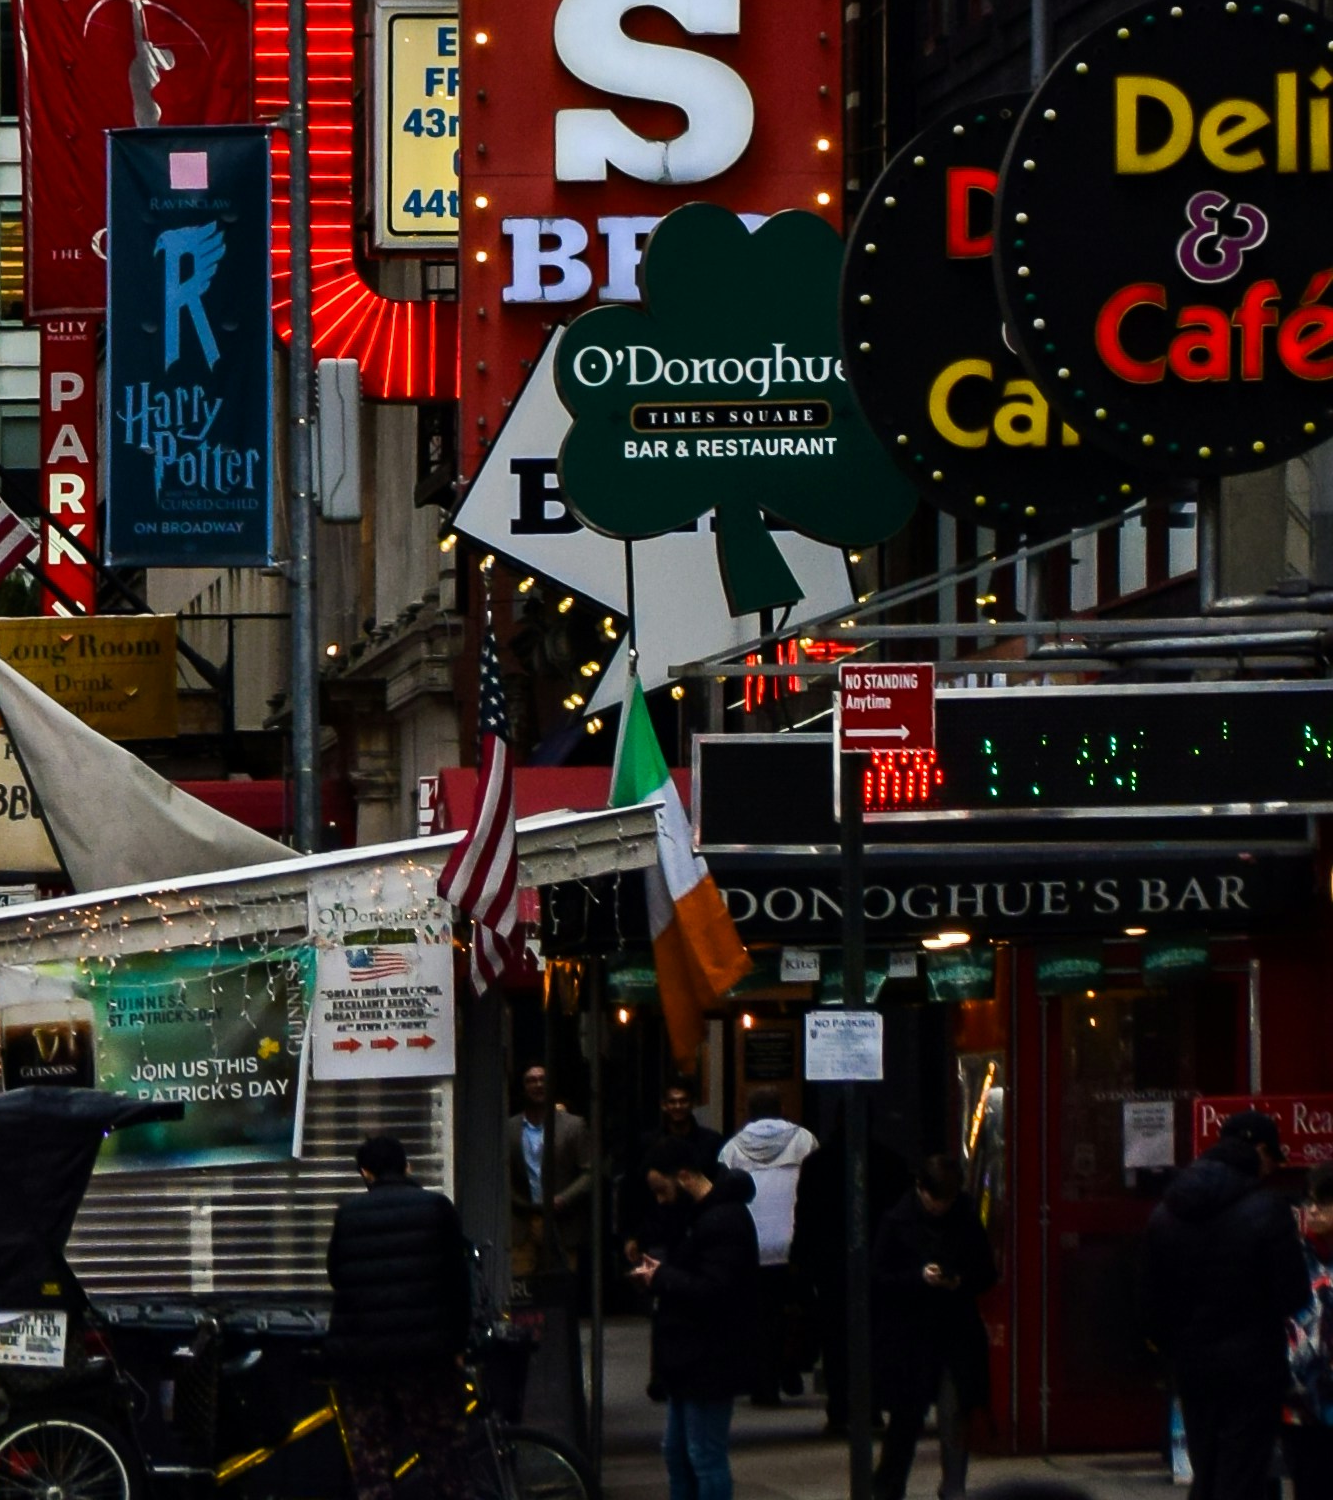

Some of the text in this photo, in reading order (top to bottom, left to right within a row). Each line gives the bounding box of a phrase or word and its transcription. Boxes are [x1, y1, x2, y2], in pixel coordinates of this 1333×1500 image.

[1114, 71, 1333, 174] Deli
[1176, 189, 1269, 284] &
[46, 322, 88, 333] CITY
[1095, 269, 1333, 384] Café
[117, 382, 224, 451] Harry
[648, 408, 814, 426] TIMES SQUARE
[624, 437, 838, 458] BAR & RESTAURANT
[47, 371, 89, 565] PARK
[152, 430, 261, 506] Potter
[161, 497, 259, 512] CURSED CHILD
[134, 521, 244, 535] ON BROADWAY
[76, 633, 161, 658] Room
[54, 674, 114, 693] Drink
[845, 672, 918, 691] NO STANDING
[845, 693, 892, 713] Anytime
[1139, 875, 1251, 913] BAR
[20, 1063, 77, 1078] GUINNESS
[131, 1057, 259, 1082] JOIN US THIS
[248, 1077, 290, 1098] DAY
